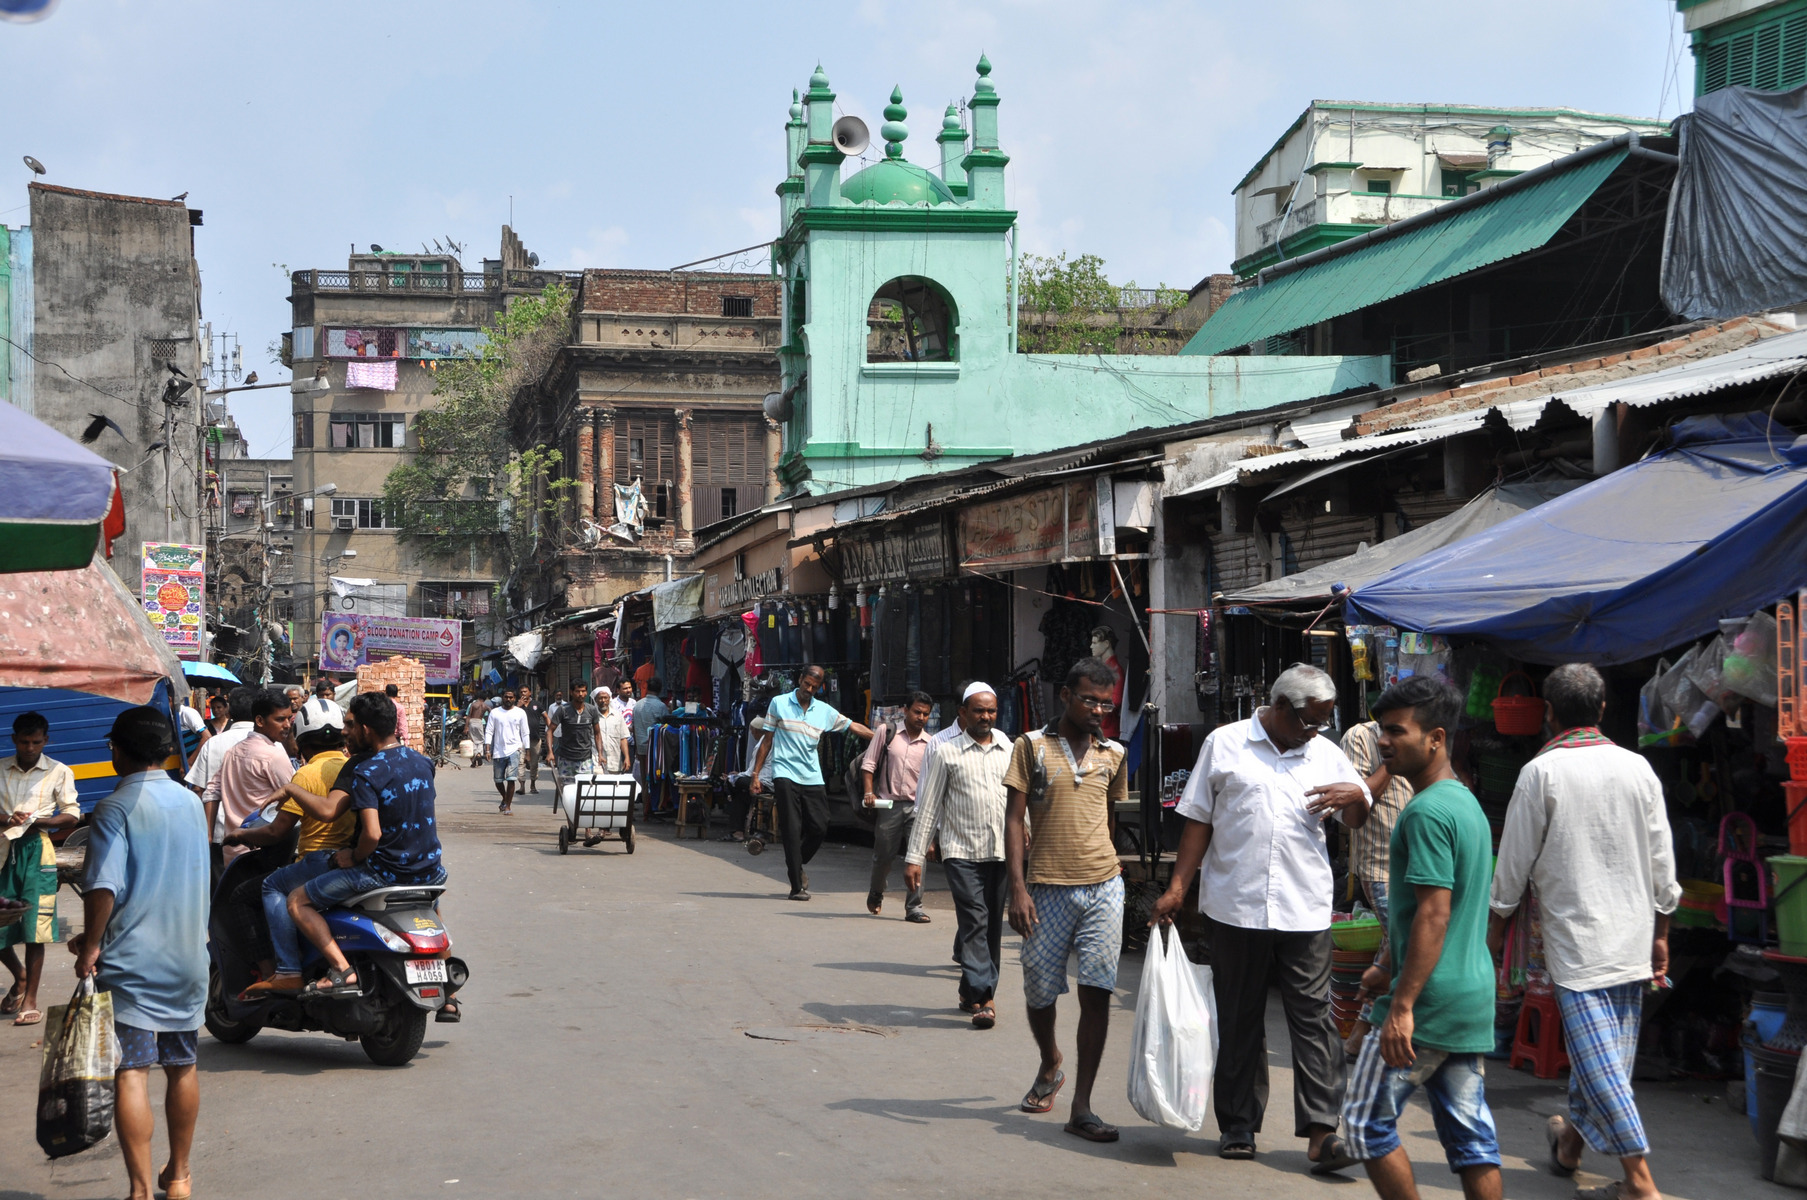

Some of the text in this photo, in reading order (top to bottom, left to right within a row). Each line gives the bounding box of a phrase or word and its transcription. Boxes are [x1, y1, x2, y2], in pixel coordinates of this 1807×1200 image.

[973, 487, 1084, 542] ALTAB STORE
[733, 554, 743, 582] AL
[743, 567, 778, 602] COLLECTION
[367, 626, 439, 640] BLOOD DONATION CAMP
[416, 971, 443, 981] H4059
